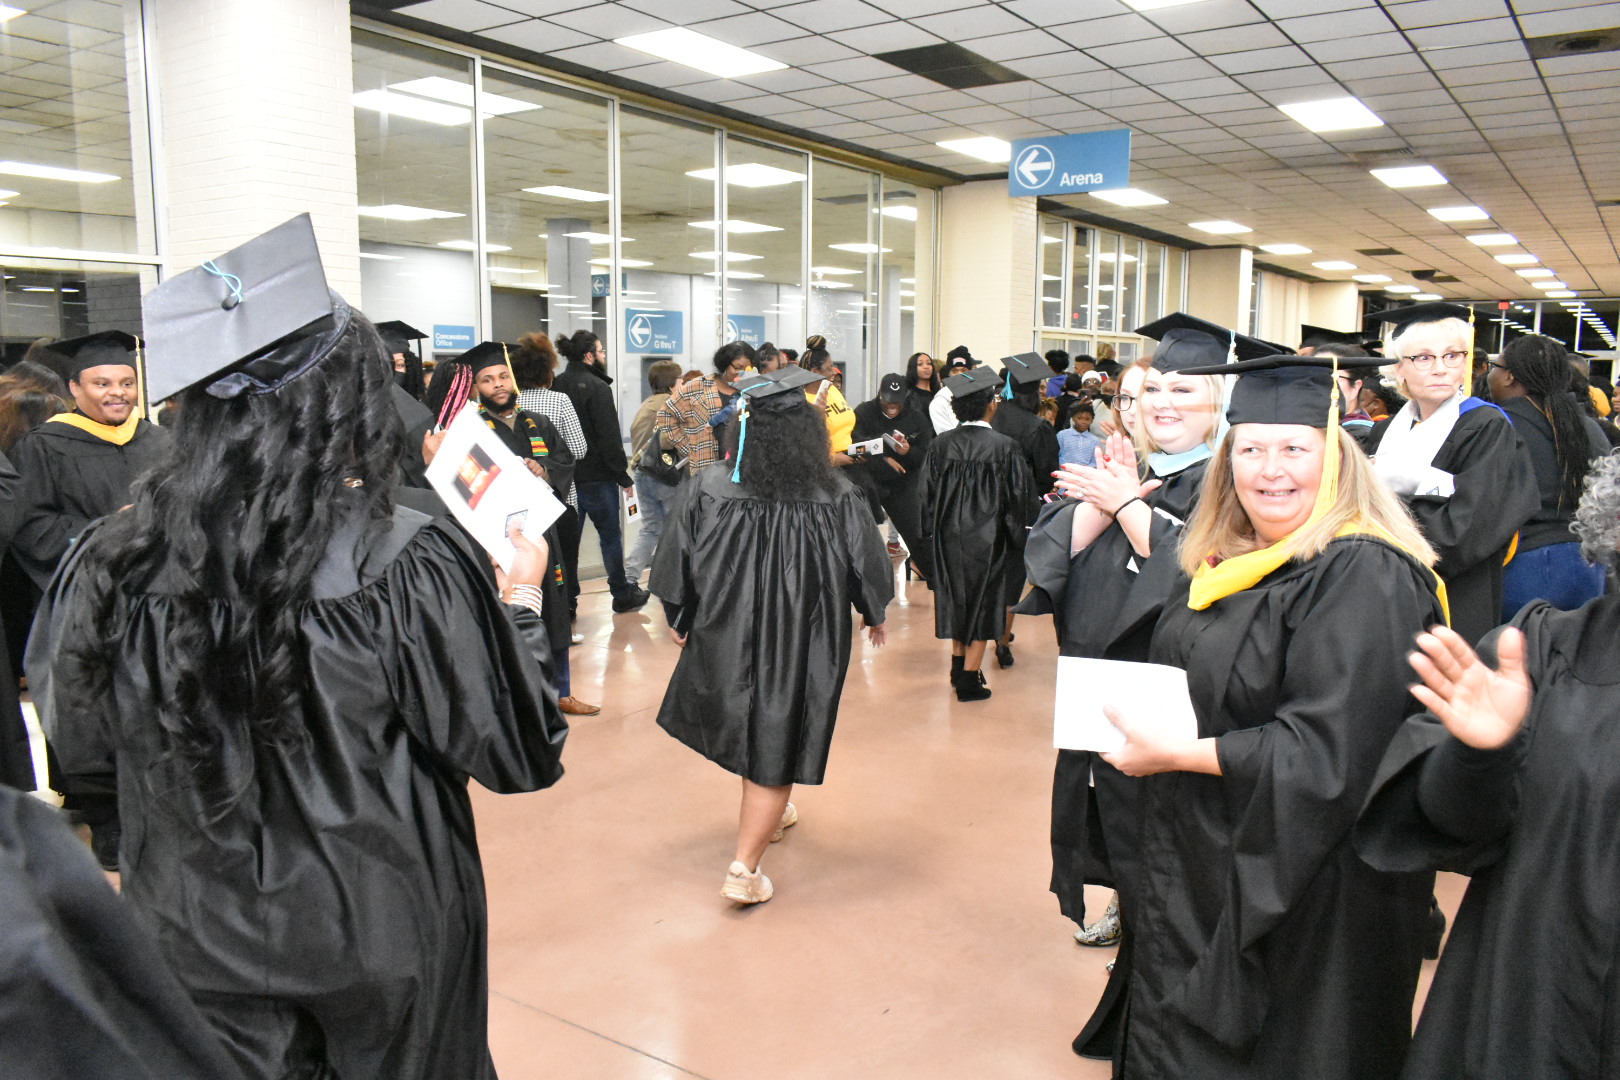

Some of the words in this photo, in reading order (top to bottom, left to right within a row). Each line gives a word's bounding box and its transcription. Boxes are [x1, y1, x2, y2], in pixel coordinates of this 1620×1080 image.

[1059, 172, 1104, 187] Arena
[655, 340, 660, 349] G
[672, 340, 676, 349] T
